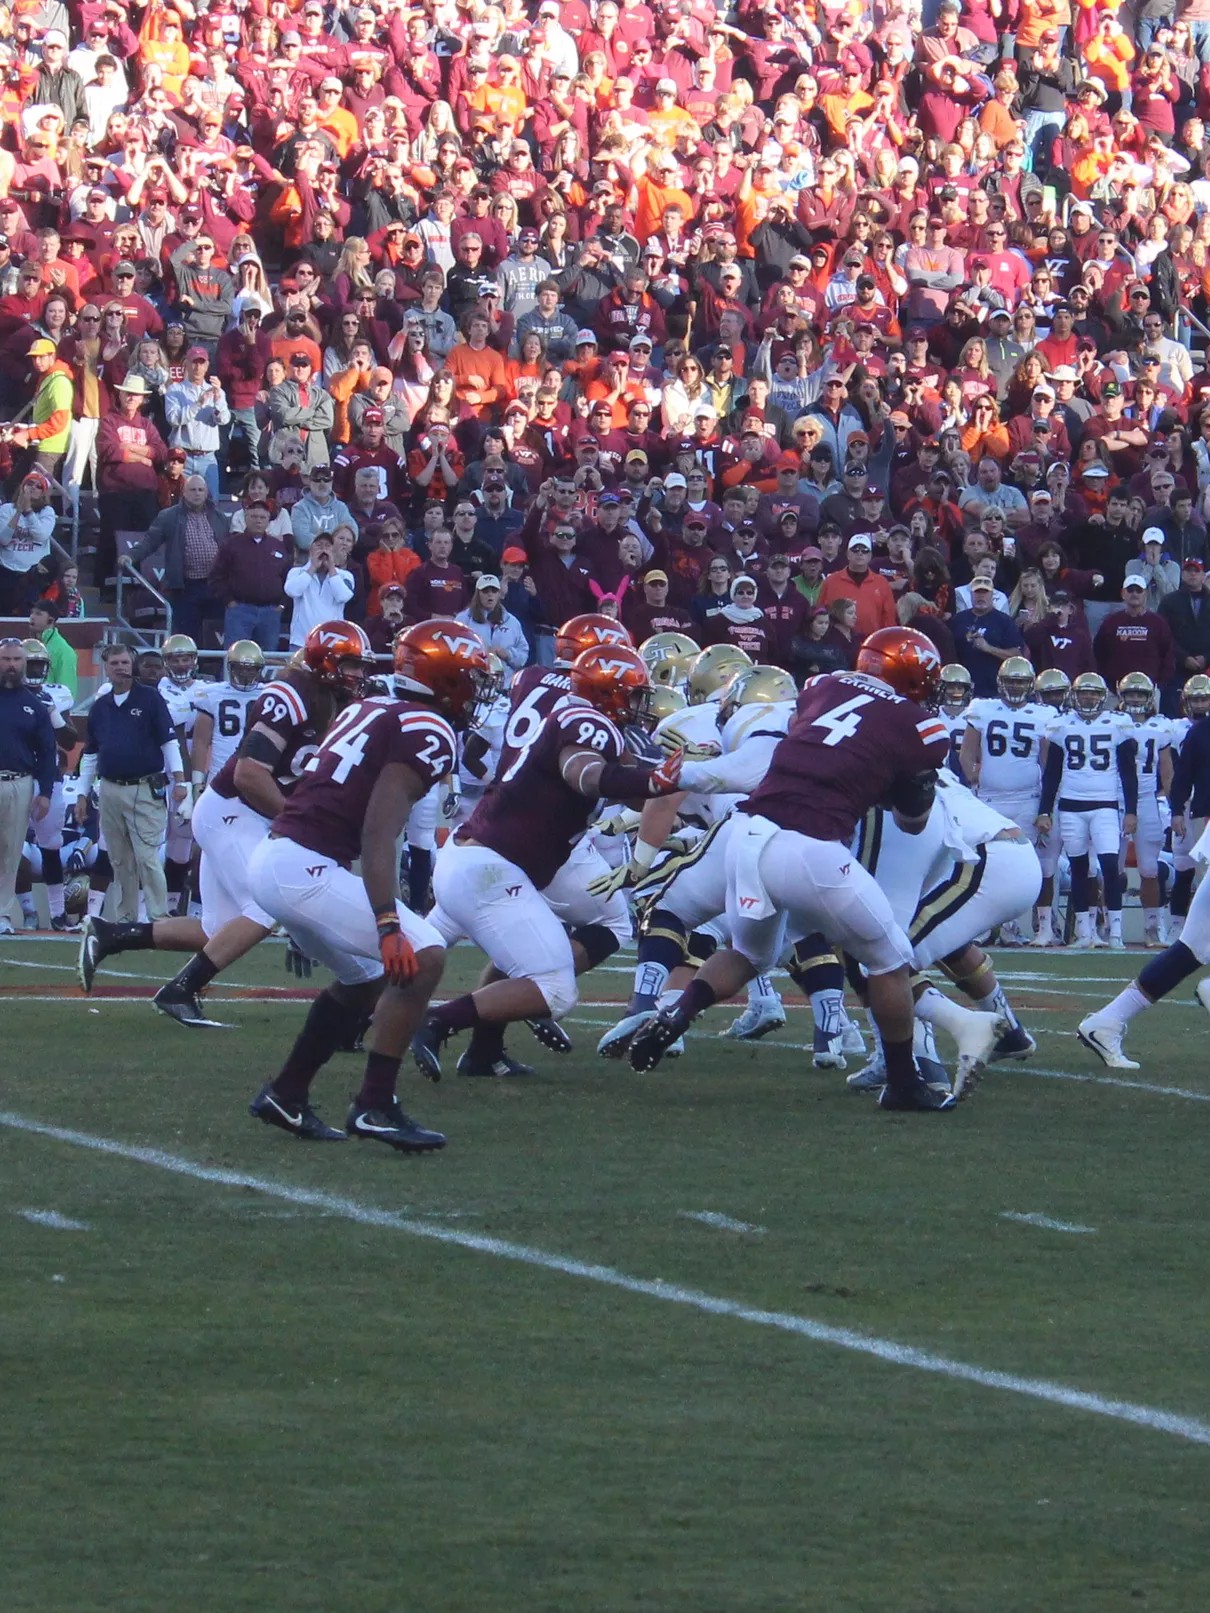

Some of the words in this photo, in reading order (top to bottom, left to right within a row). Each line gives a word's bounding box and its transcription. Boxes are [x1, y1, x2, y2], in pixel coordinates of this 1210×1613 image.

[1044, 259, 1069, 272] VT
[519, 450, 533, 458] VT
[312, 514, 335, 529] VT
[579, 567, 589, 575] VT
[319, 630, 349, 649] VT
[593, 627, 625, 645] VT
[1116, 628, 1149, 636] MAROON
[442, 635, 481, 660] VT
[643, 642, 674, 661] GT
[1051, 635, 1072, 649] VT
[914, 646, 940, 671] VT
[598, 658, 635, 679] VT
[540, 672, 571, 691] BAR
[261, 696, 288, 724] 99
[811, 694, 874, 746] 4
[304, 704, 387, 785] 24
[576, 721, 609, 752] 98
[986, 721, 1035, 759] 65
[416, 735, 451, 777] 24
[1064, 735, 1112, 771] 85
[222, 815, 239, 825] VT
[306, 865, 328, 878] VT
[839, 863, 851, 876] VT
[505, 885, 523, 897] VT
[739, 896, 761, 909] VT
